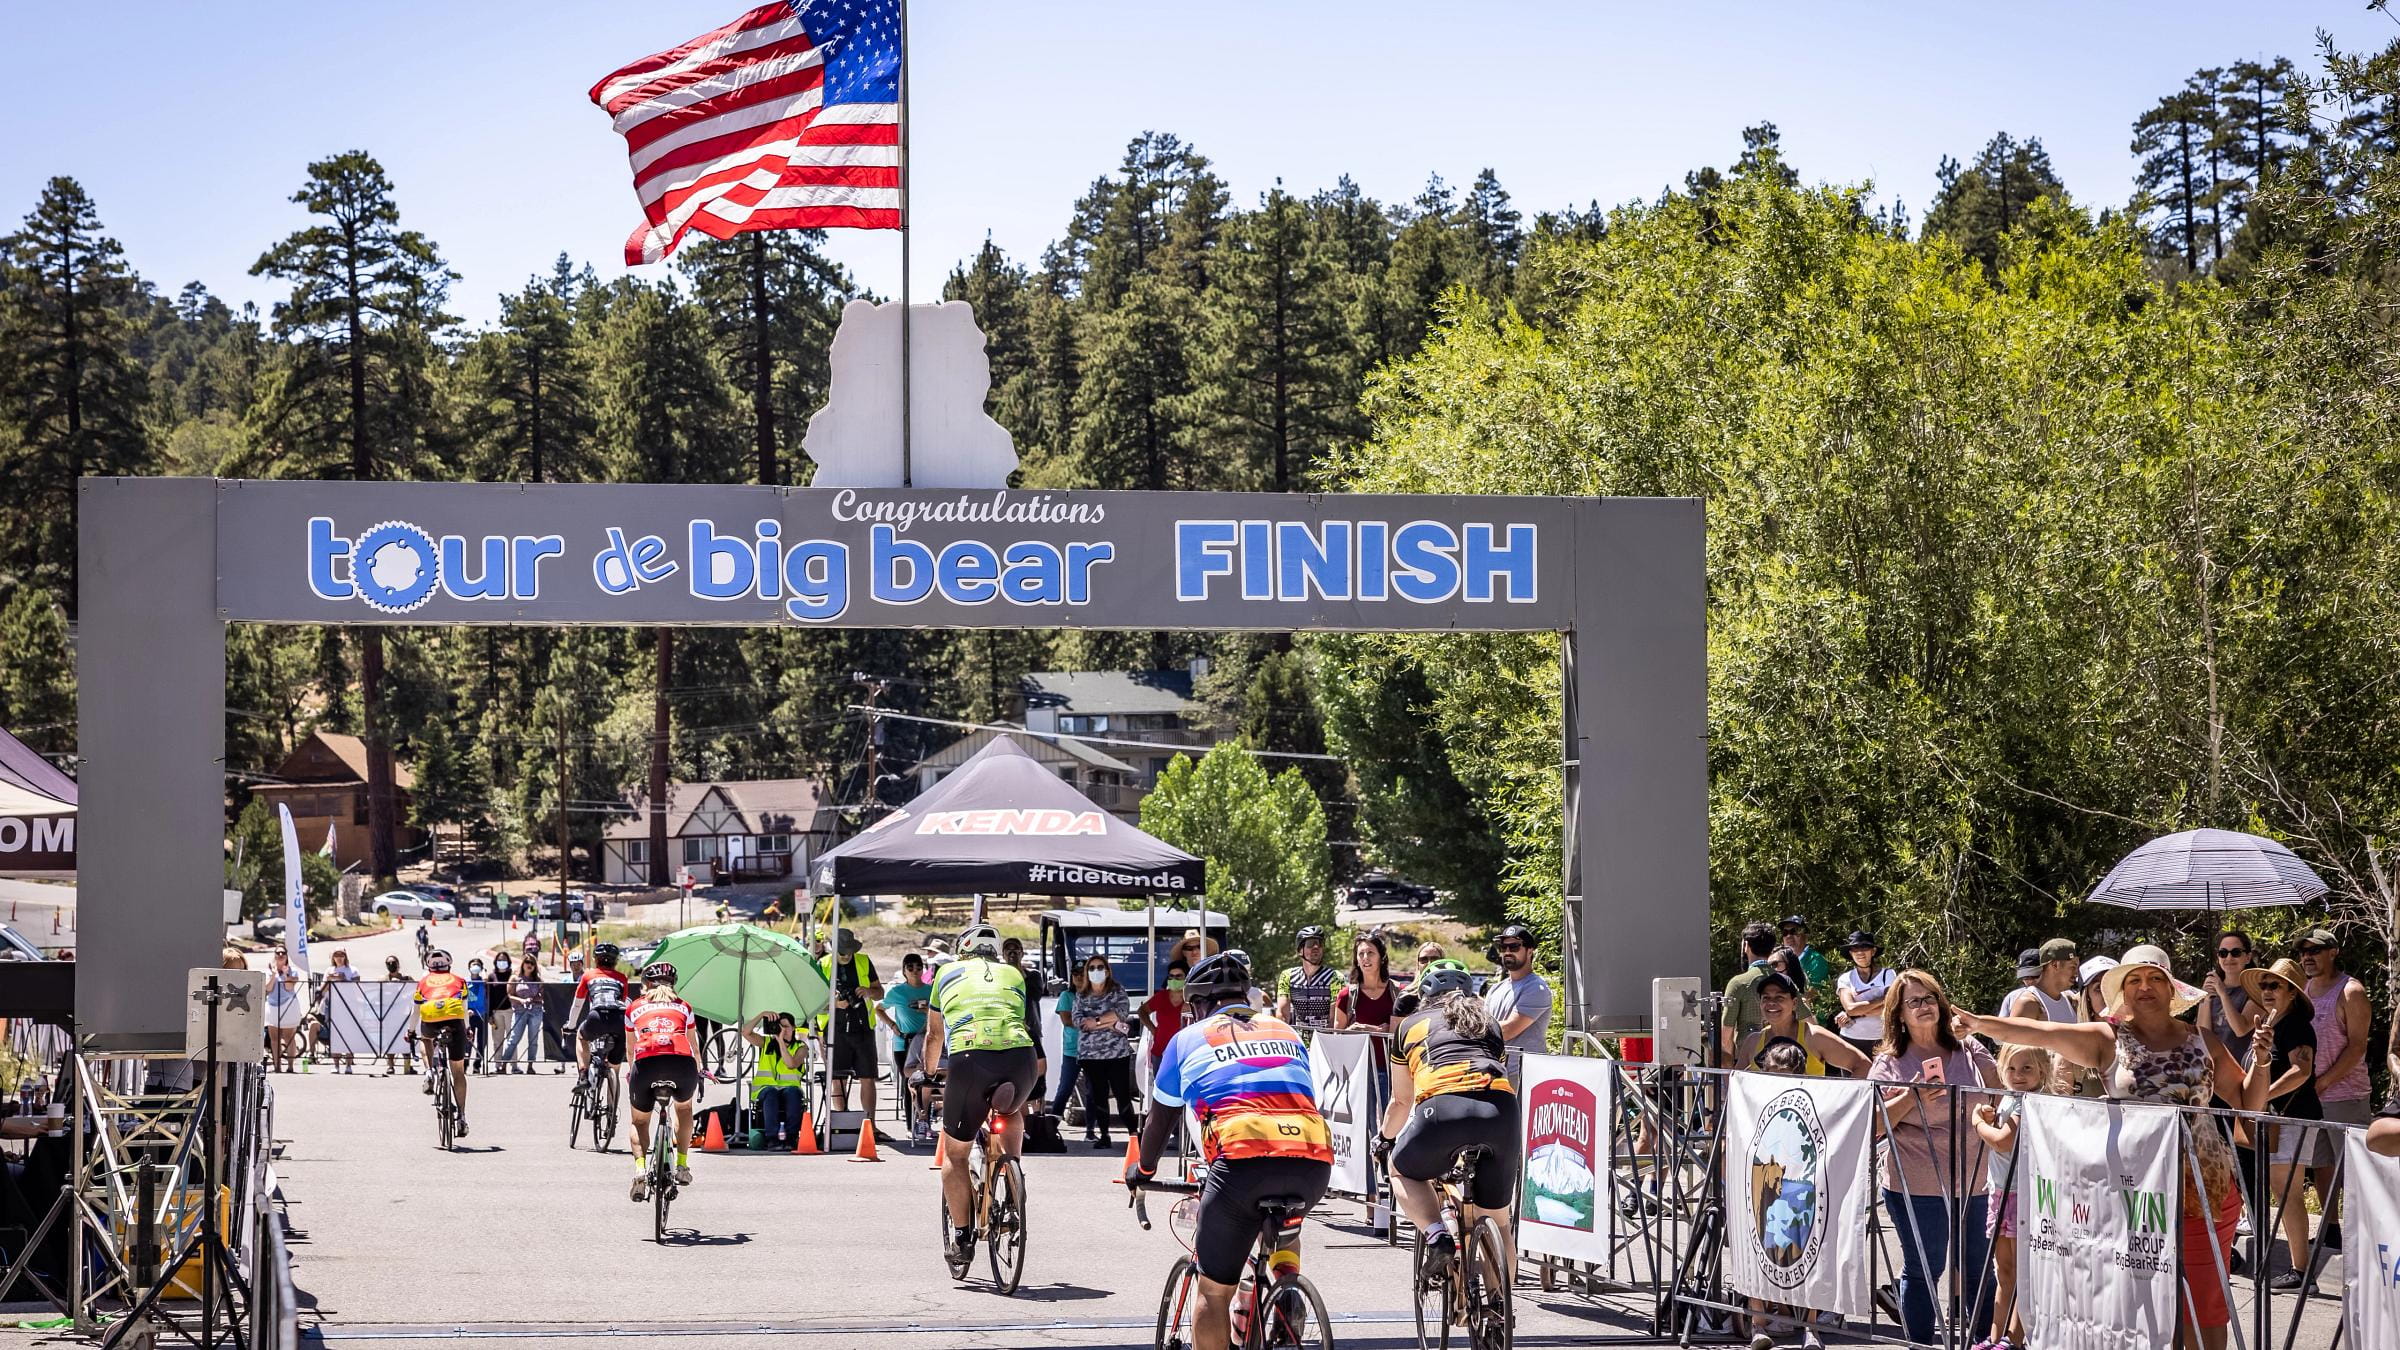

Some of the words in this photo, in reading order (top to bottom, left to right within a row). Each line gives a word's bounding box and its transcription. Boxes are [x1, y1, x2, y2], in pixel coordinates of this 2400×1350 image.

[832, 490, 1106, 533] Congratulations
[308, 516, 564, 614] tour
[594, 526, 678, 595] de
[689, 518, 849, 622] big
[871, 523, 1114, 606] bear
[1174, 519, 1538, 604] FINISH
[914, 808, 1108, 836] KENDA
[1028, 864, 1186, 890] #ridekenda
[1767, 1101, 1779, 1118] OF
[1779, 1093, 1795, 1108] BG
[1794, 1095, 1811, 1121] BEAR
[1531, 1101, 1589, 1147] ARROWHEAD
[2120, 1174, 2135, 1187] THE
[2071, 1193, 2091, 1225] kw
[1804, 1236, 1819, 1267] 1980
[2128, 1236, 2165, 1255] GROUP
